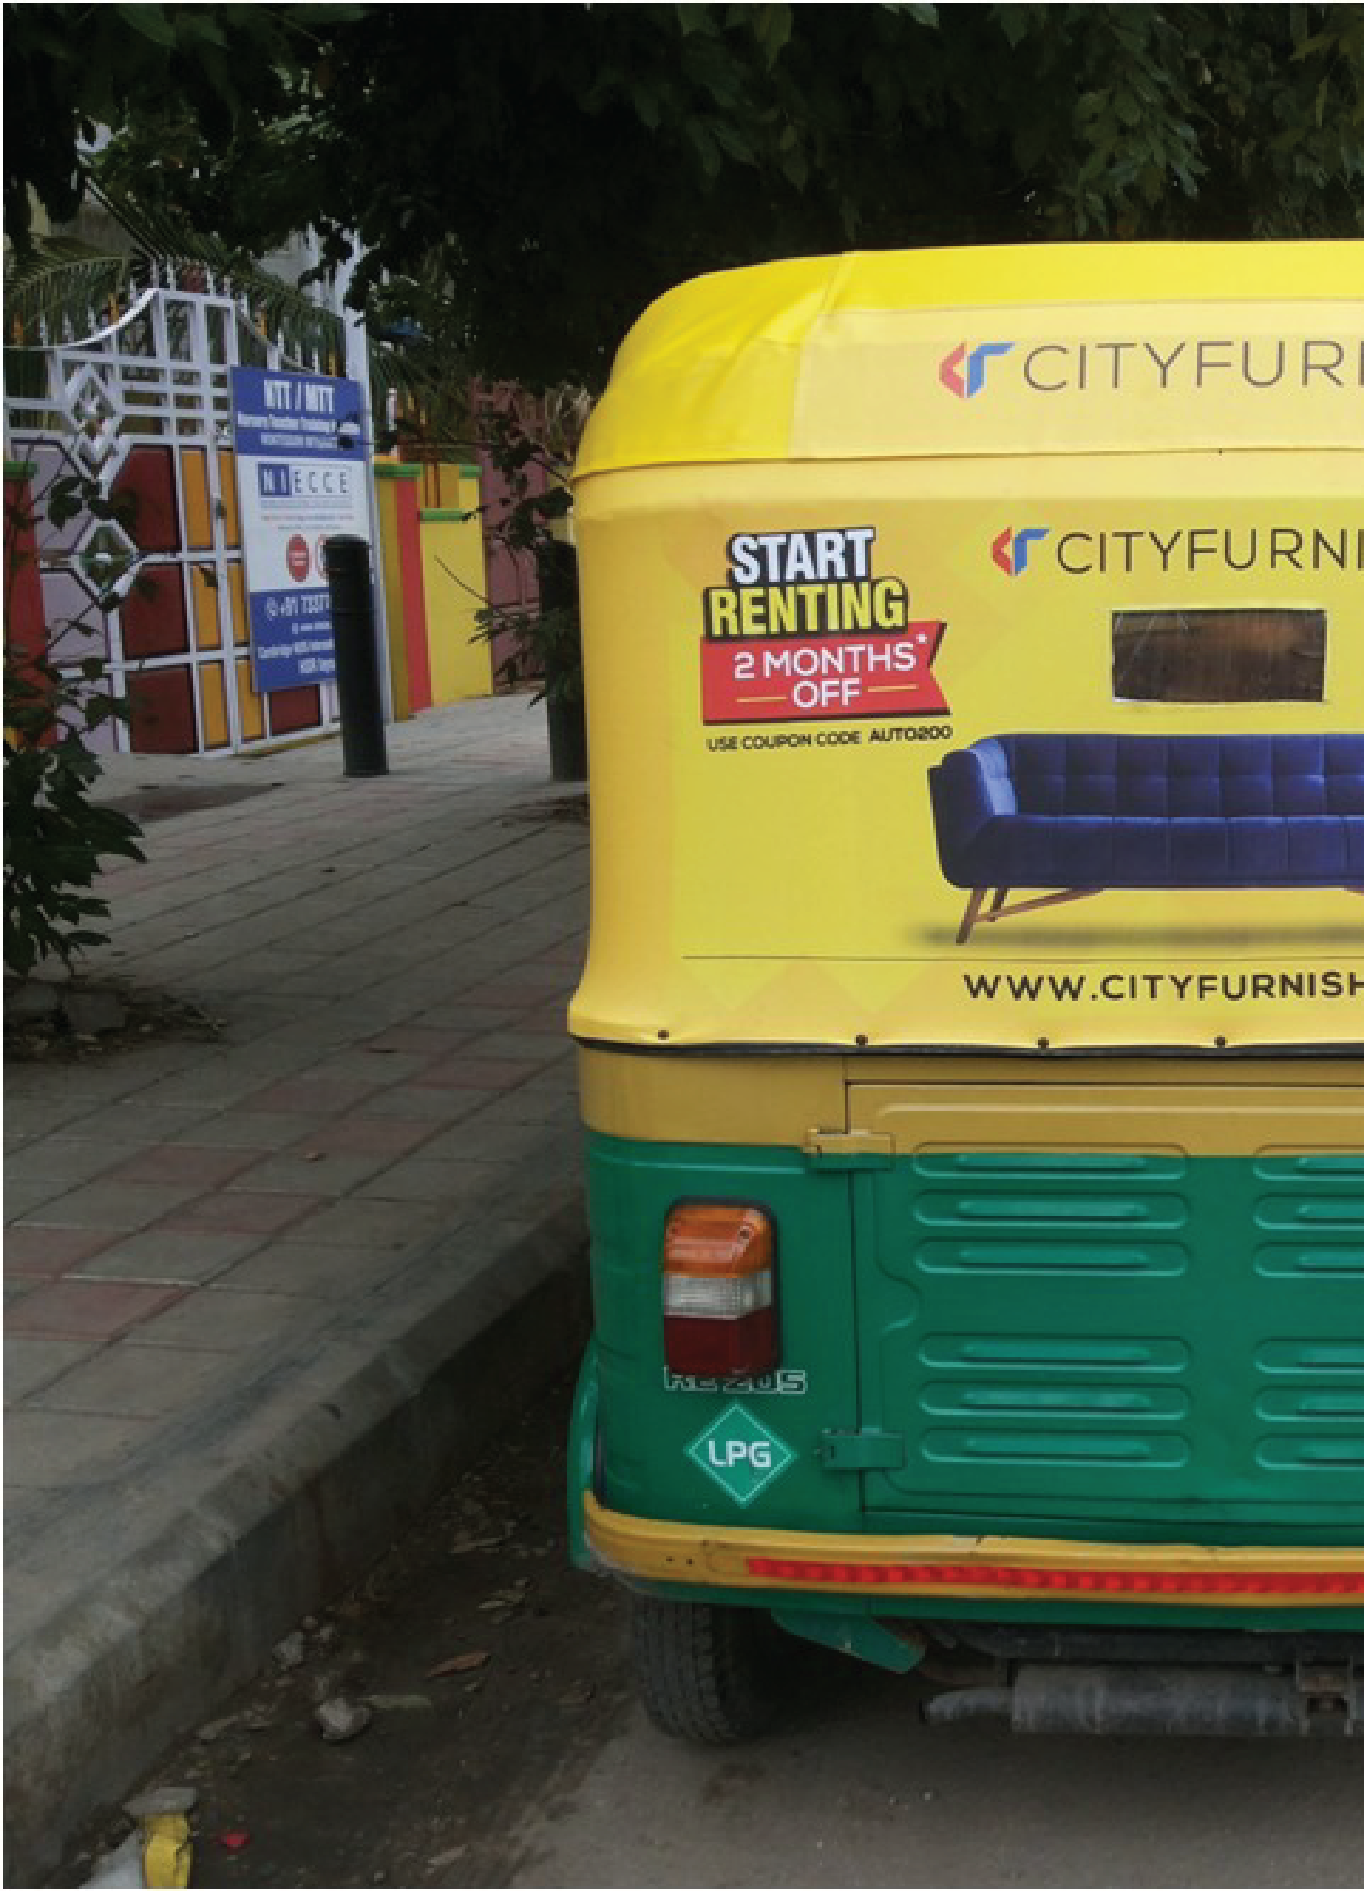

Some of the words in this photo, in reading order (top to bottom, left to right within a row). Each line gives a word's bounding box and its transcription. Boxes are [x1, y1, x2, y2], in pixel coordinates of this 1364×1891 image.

[731, 528, 874, 585] START
[710, 580, 904, 636] RENTING
[733, 650, 755, 680] 2
[793, 677, 863, 708] OFF
[706, 733, 738, 752] USE
[741, 729, 811, 750] COUPON
[816, 729, 863, 746] CODE
[867, 725, 954, 745] AUTO200
[707, 1439, 772, 1468] LPG
